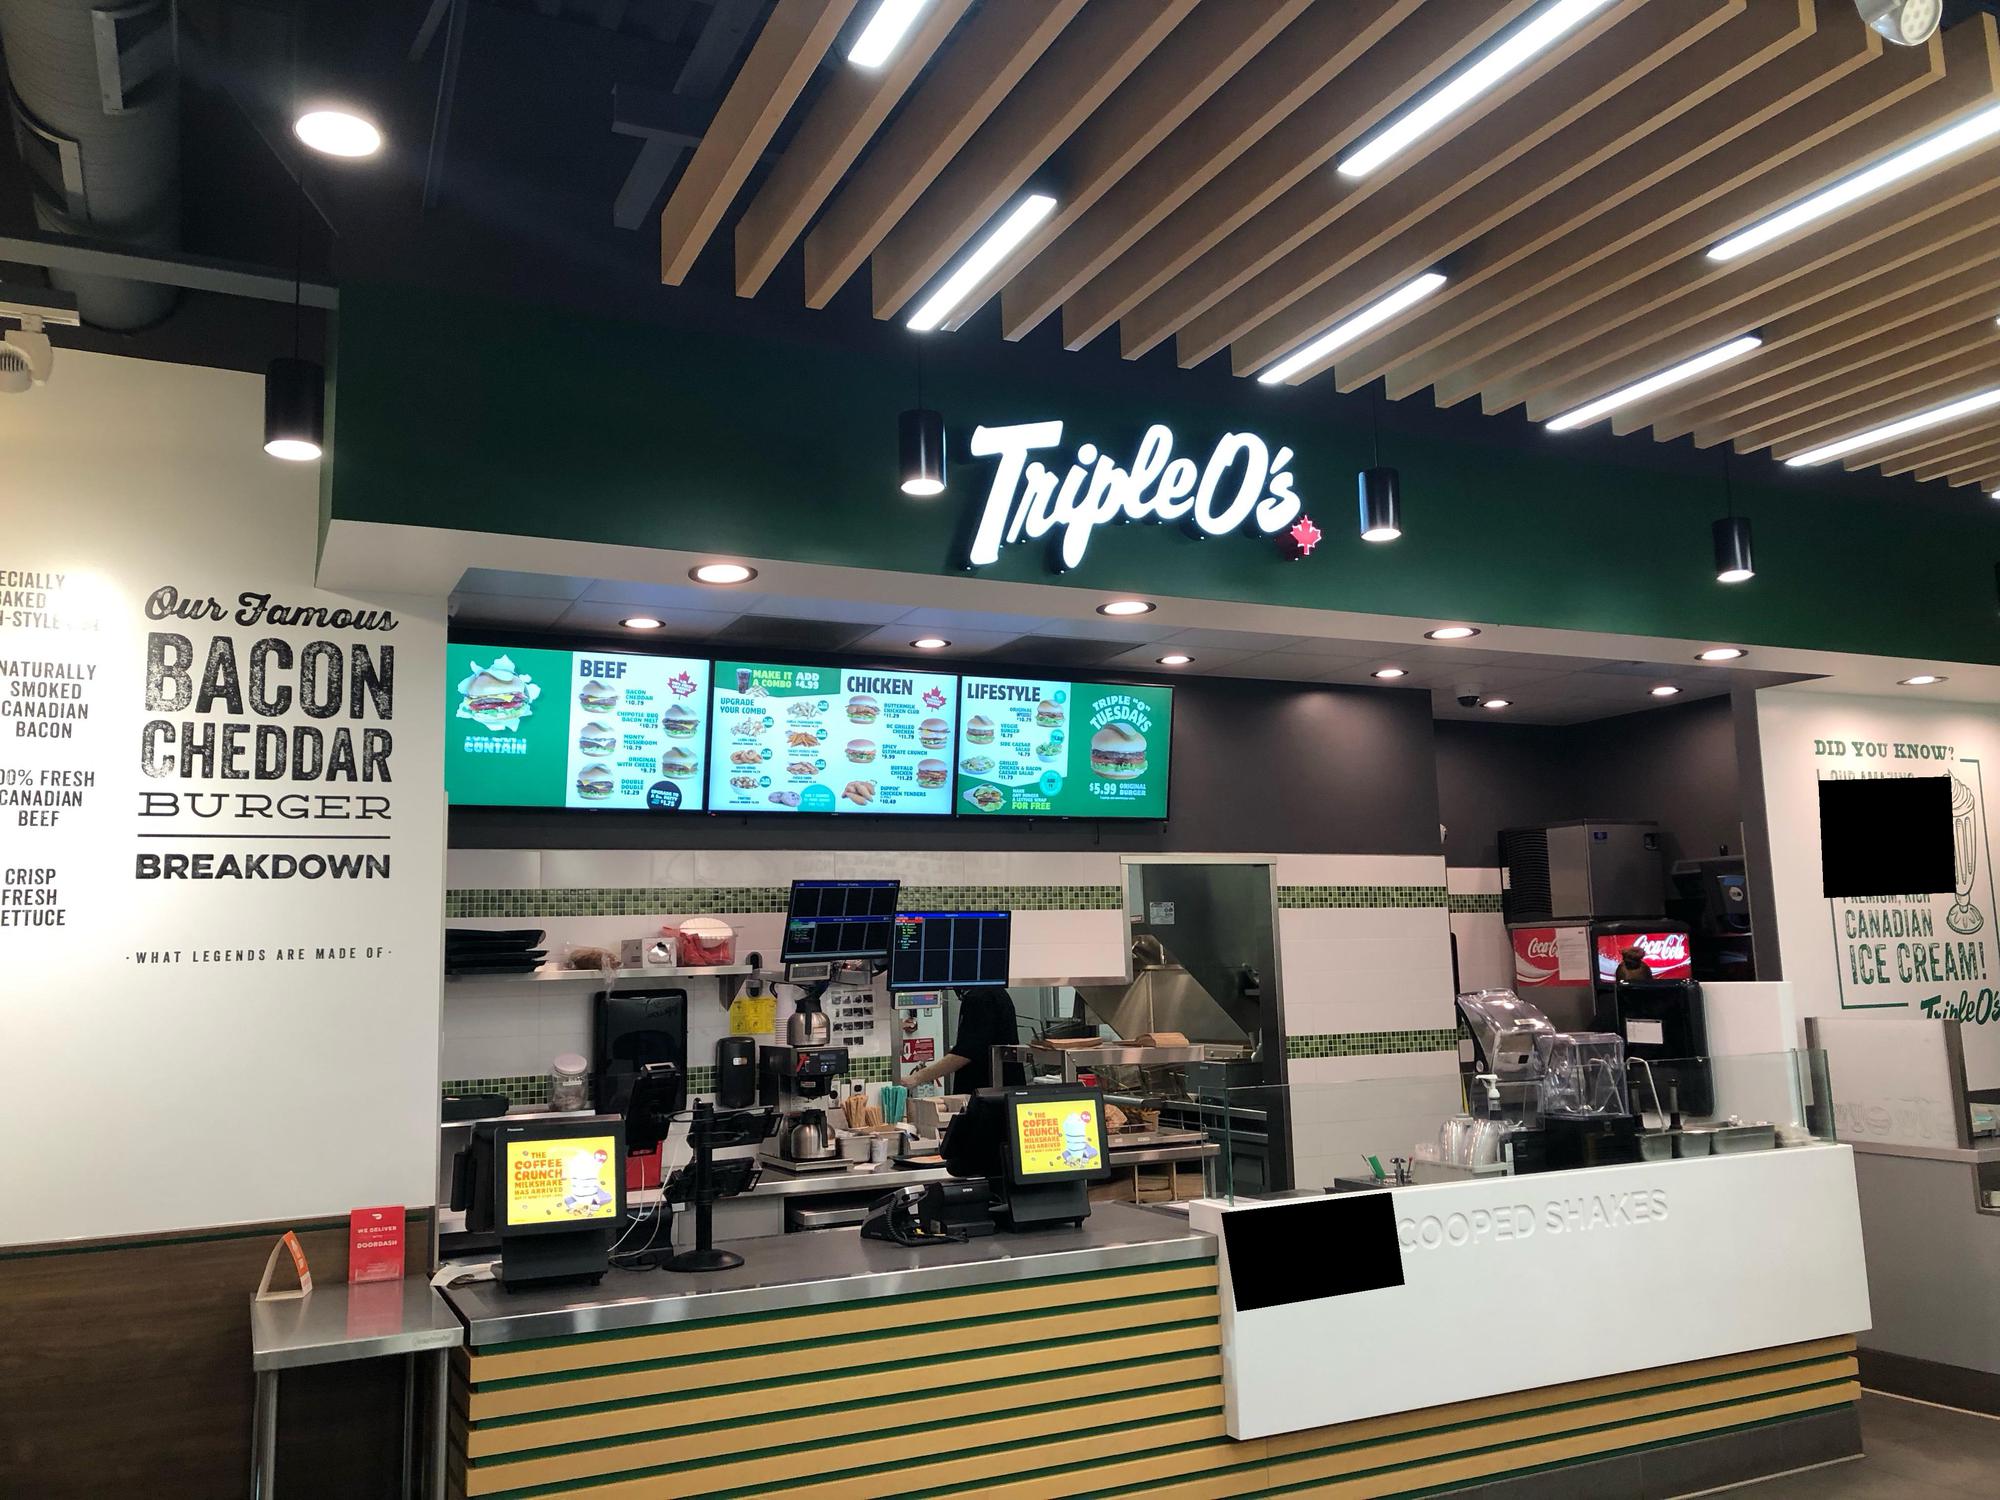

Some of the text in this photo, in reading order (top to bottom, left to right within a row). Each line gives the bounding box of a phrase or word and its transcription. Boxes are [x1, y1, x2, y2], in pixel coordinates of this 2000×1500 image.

[0, 590, 46, 608] AKED
[144, 585, 399, 631] Our Famous
[0, 660, 96, 680] NATURALLY
[145, 632, 394, 720] BACON
[580, 659, 627, 679] BEEF
[753, 670, 792, 680] MAKE IT
[796, 672, 819, 681] ADD
[10, 681, 82, 699] SMOKED
[761, 680, 792, 688] COMBO
[795, 680, 819, 689] $4.99
[847, 676, 913, 695] CHICKEN
[967, 683, 1041, 702] LIFESTYLE
[2, 700, 88, 719] CANADIAN
[720, 697, 755, 706] UPGRADE
[1092, 695, 1131, 712] TRIPLE
[720, 706, 767, 715] YOUR COMBO
[1089, 705, 1152, 733] TUESDAYS
[16, 721, 72, 738] BACON
[140, 720, 393, 783] CHEDDAR
[1814, 739, 1955, 761] DID YOU KNOW?
[40, 770, 95, 787] FRESH
[1089, 782, 1117, 795] $5.99
[0, 789, 82, 807] CANADIAN
[138, 792, 392, 820] BURGER
[1012, 802, 1051, 810] FOR FREE
[18, 810, 60, 826] BEEF
[135, 854, 391, 880] BREAKDOWN
[5, 868, 57, 885] CRISP
[2, 889, 57, 906] FRESH
[1845, 909, 1933, 939] CANADIAN
[136, 951, 183, 964] WHAT
[192, 950, 266, 963] LEGENDS
[276, 949, 305, 961] ARE
[316, 948, 356, 960] MADE
[1850, 941, 1987, 985] ICE CREAM!
[1023, 1118, 1058, 1128] COFFEE
[1023, 1127, 1059, 1137] CRUNCH
[515, 1159, 562, 1170] COFFEE
[515, 1169, 562, 1181] CRUNCH
[514, 1180, 563, 1188] MILKSHAKE
[1399, 1189, 1668, 1253] COOPED SHAKES
[357, 1240, 398, 1249] DOORDASH
